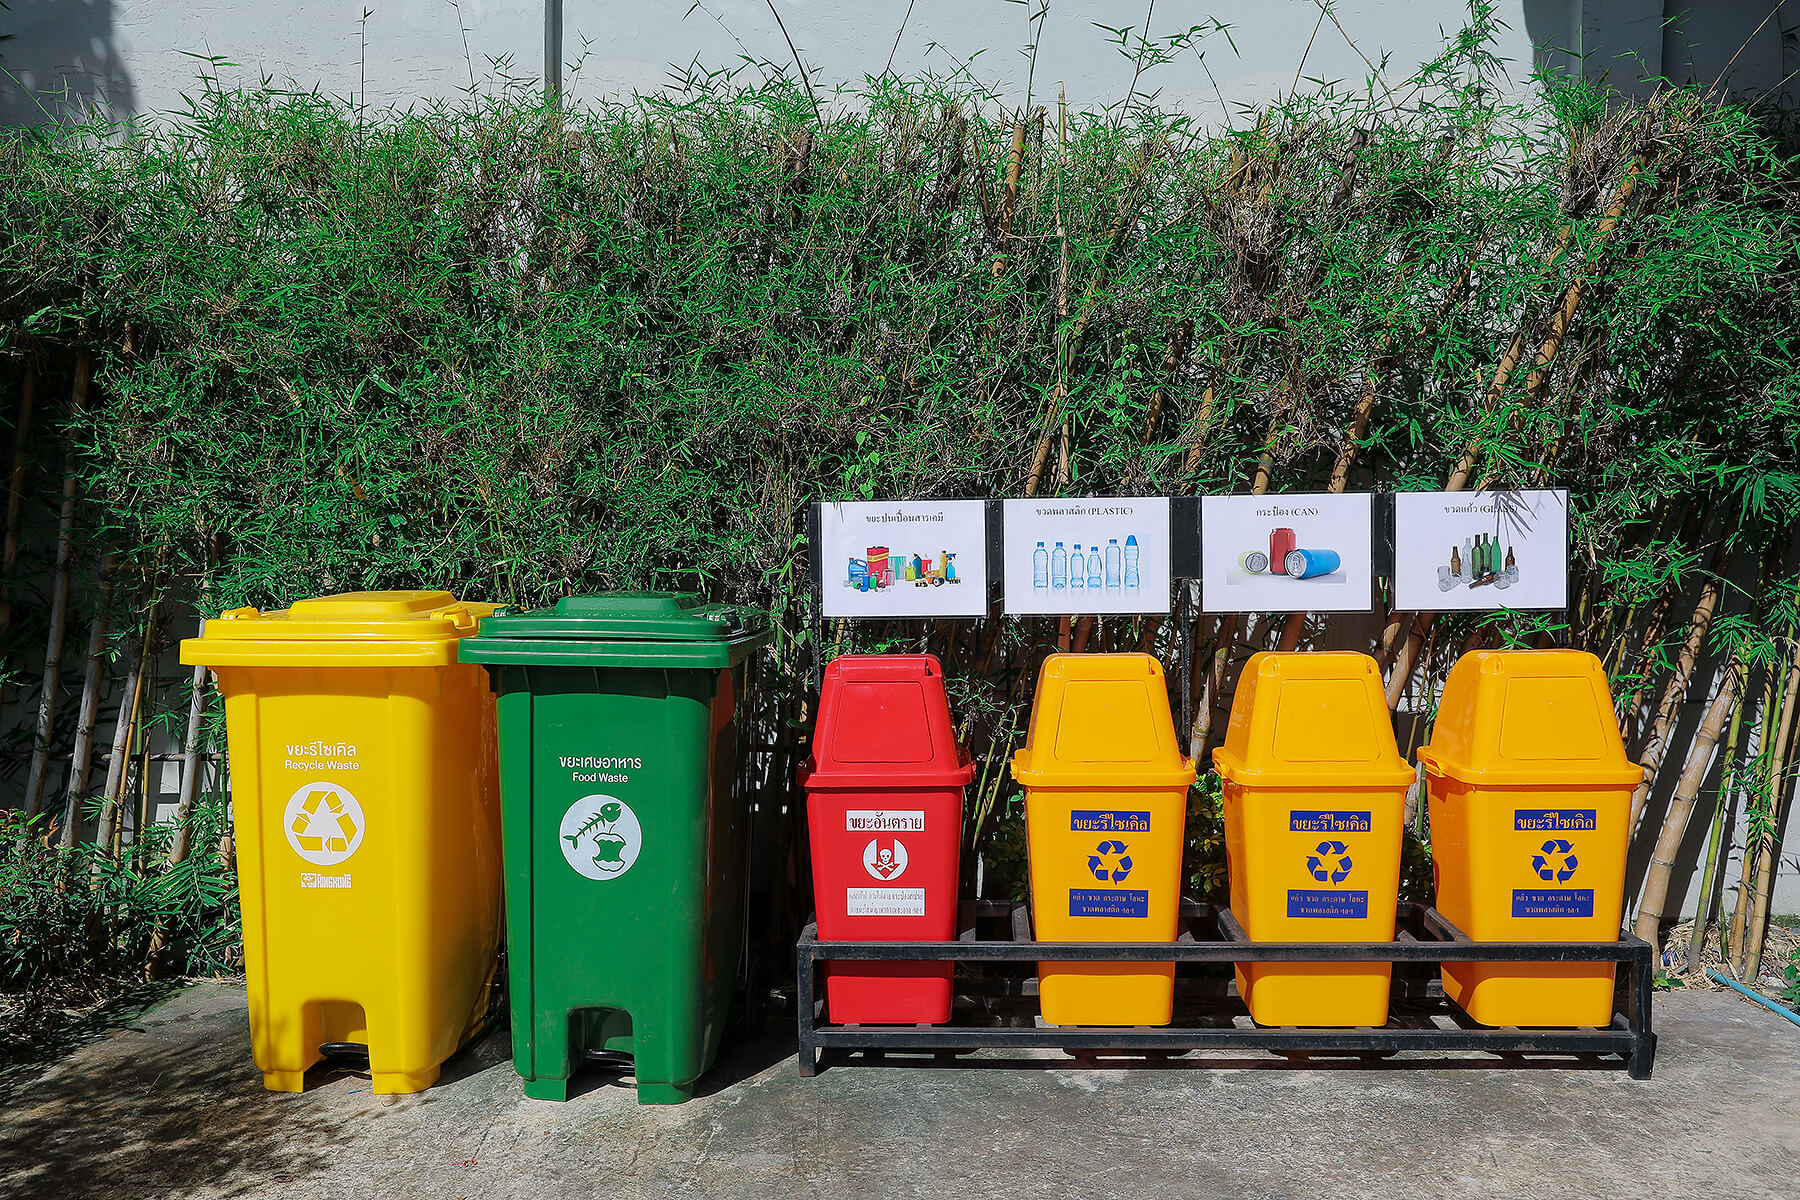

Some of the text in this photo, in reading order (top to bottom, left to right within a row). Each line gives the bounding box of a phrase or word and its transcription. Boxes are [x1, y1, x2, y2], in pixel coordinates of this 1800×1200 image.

[1036, 504, 1133, 516] ขวดพลาสติก (PLASTIC)
[1256, 506, 1318, 517] กระป๋อง (CAN)
[1444, 502, 1477, 514] ขวดแก้ว
[286, 741, 357, 756] ขยะรีไซเคิล
[284, 760, 360, 772] Recycle Waste
[559, 756, 642, 769] ขยะเศษอาหาร
[572, 772, 629, 783] Food Waste
[849, 812, 922, 829] ขยะอันตราย
[1074, 813, 1148, 830] ขยะรีไซเคิล
[1293, 813, 1369, 830] ขยะรีไซเคิล
[1517, 812, 1594, 829] ขยะรีไซเคิล
